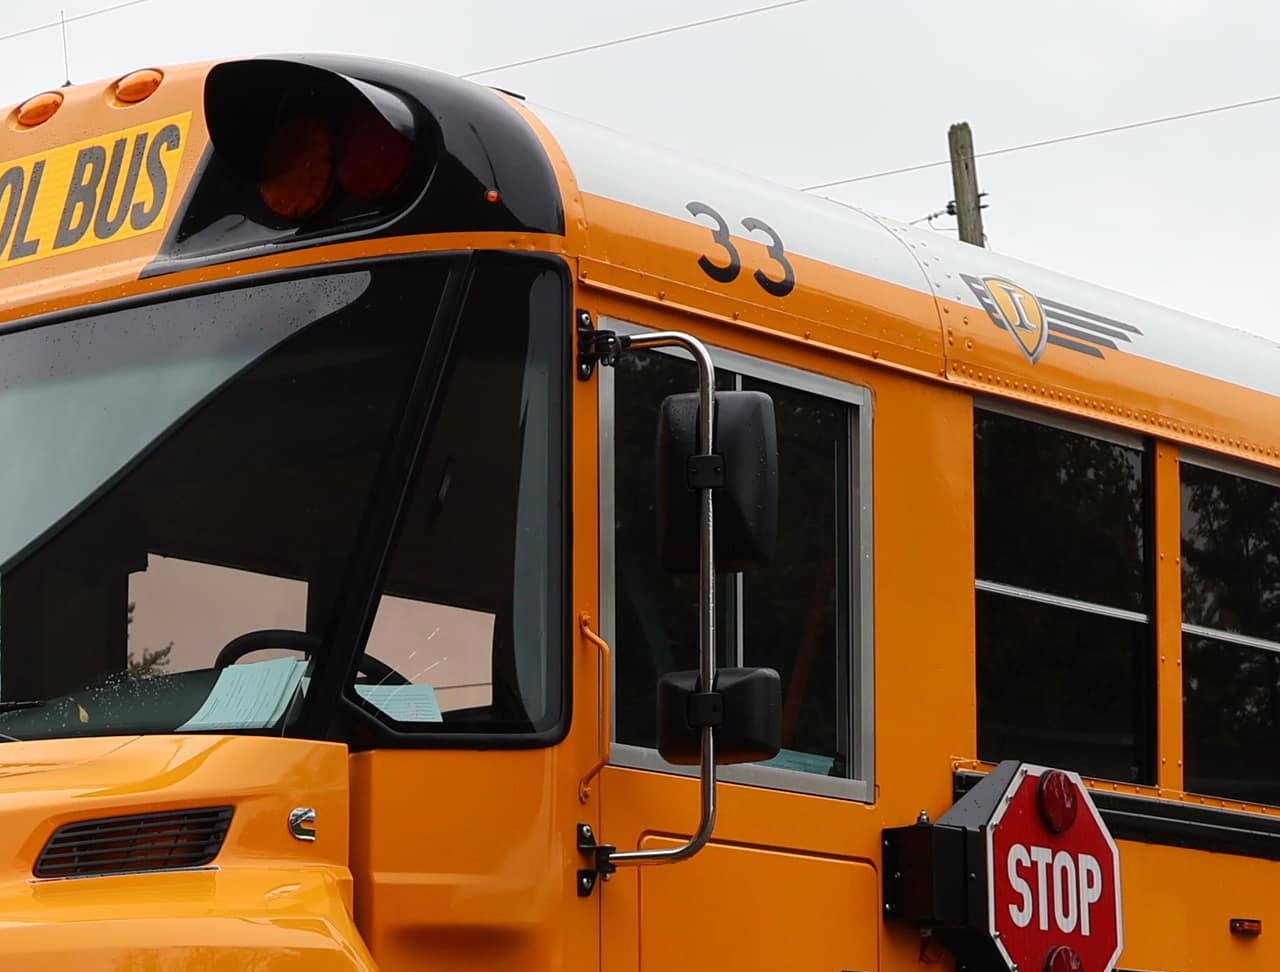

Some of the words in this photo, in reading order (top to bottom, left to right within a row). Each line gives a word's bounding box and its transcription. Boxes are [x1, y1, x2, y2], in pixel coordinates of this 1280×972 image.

[53, 124, 180, 249] BUS
[685, 201, 795, 297] 33
[1007, 843, 1102, 936] STOP
